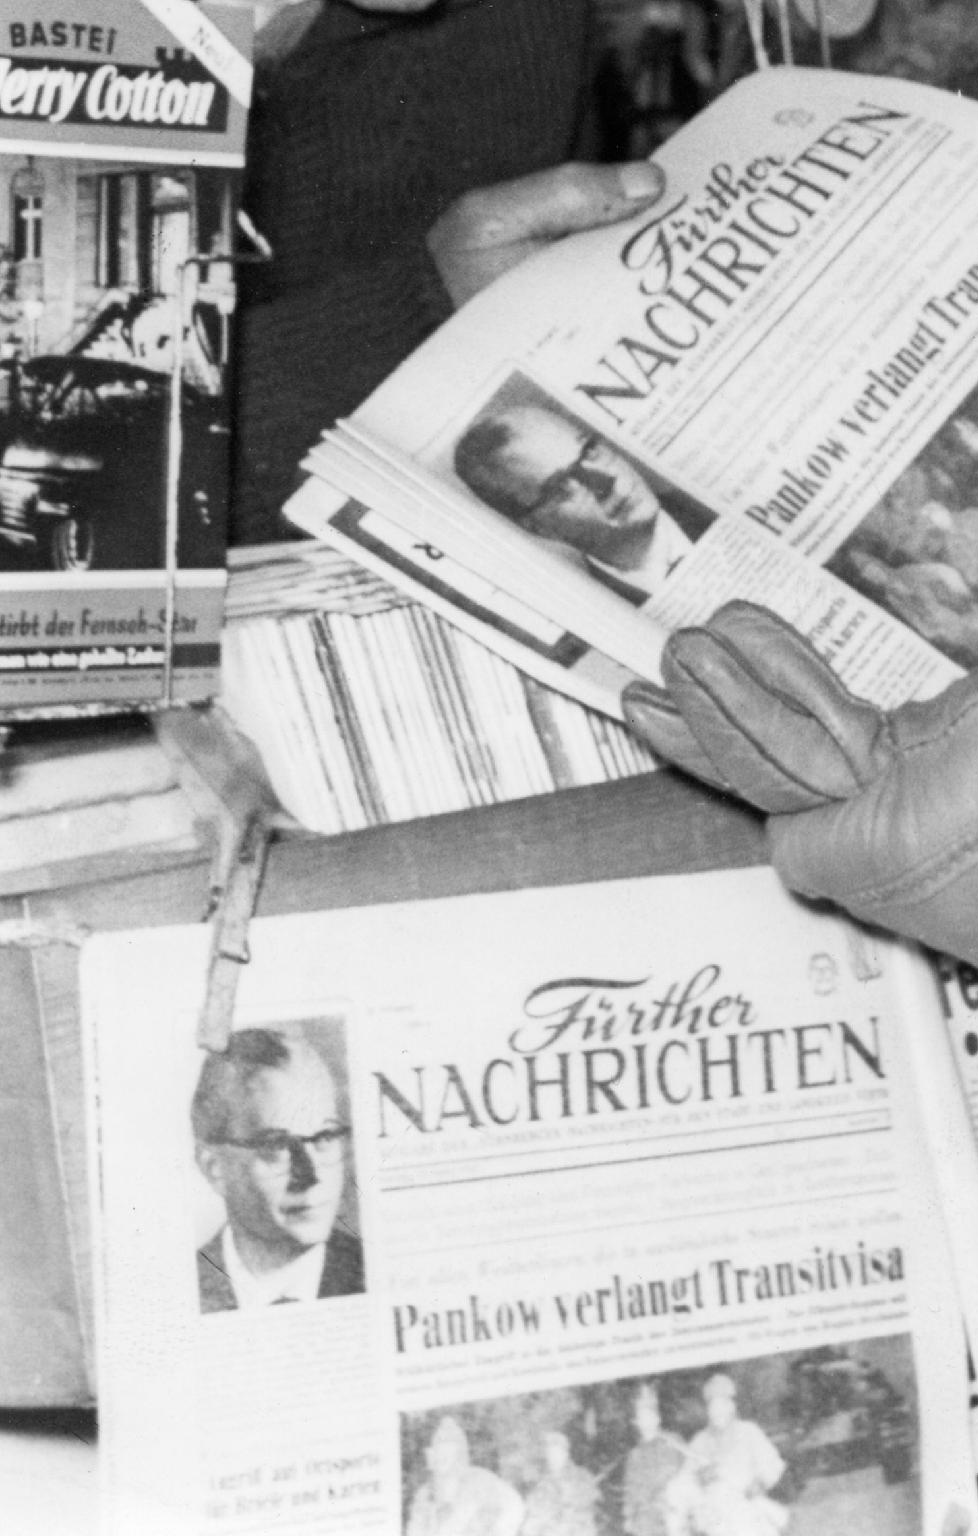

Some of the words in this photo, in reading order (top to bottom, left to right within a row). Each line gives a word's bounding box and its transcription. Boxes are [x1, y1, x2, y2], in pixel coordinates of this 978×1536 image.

[86, 64, 215, 126] Cotton
[573, 100, 911, 426] NACHRICHTEN
[620, 154, 787, 297] Fürther
[745, 437, 849, 537] Pankow
[840, 320, 946, 435] verlangt
[45, 609, 75, 636] der
[509, 963, 760, 1054] Fürther
[371, 1016, 888, 1138] NACHRICHTEN
[393, 1295, 541, 1354] Pankow
[553, 1271, 703, 1326] verlangt
[710, 1240, 906, 1308] Transitvisa
